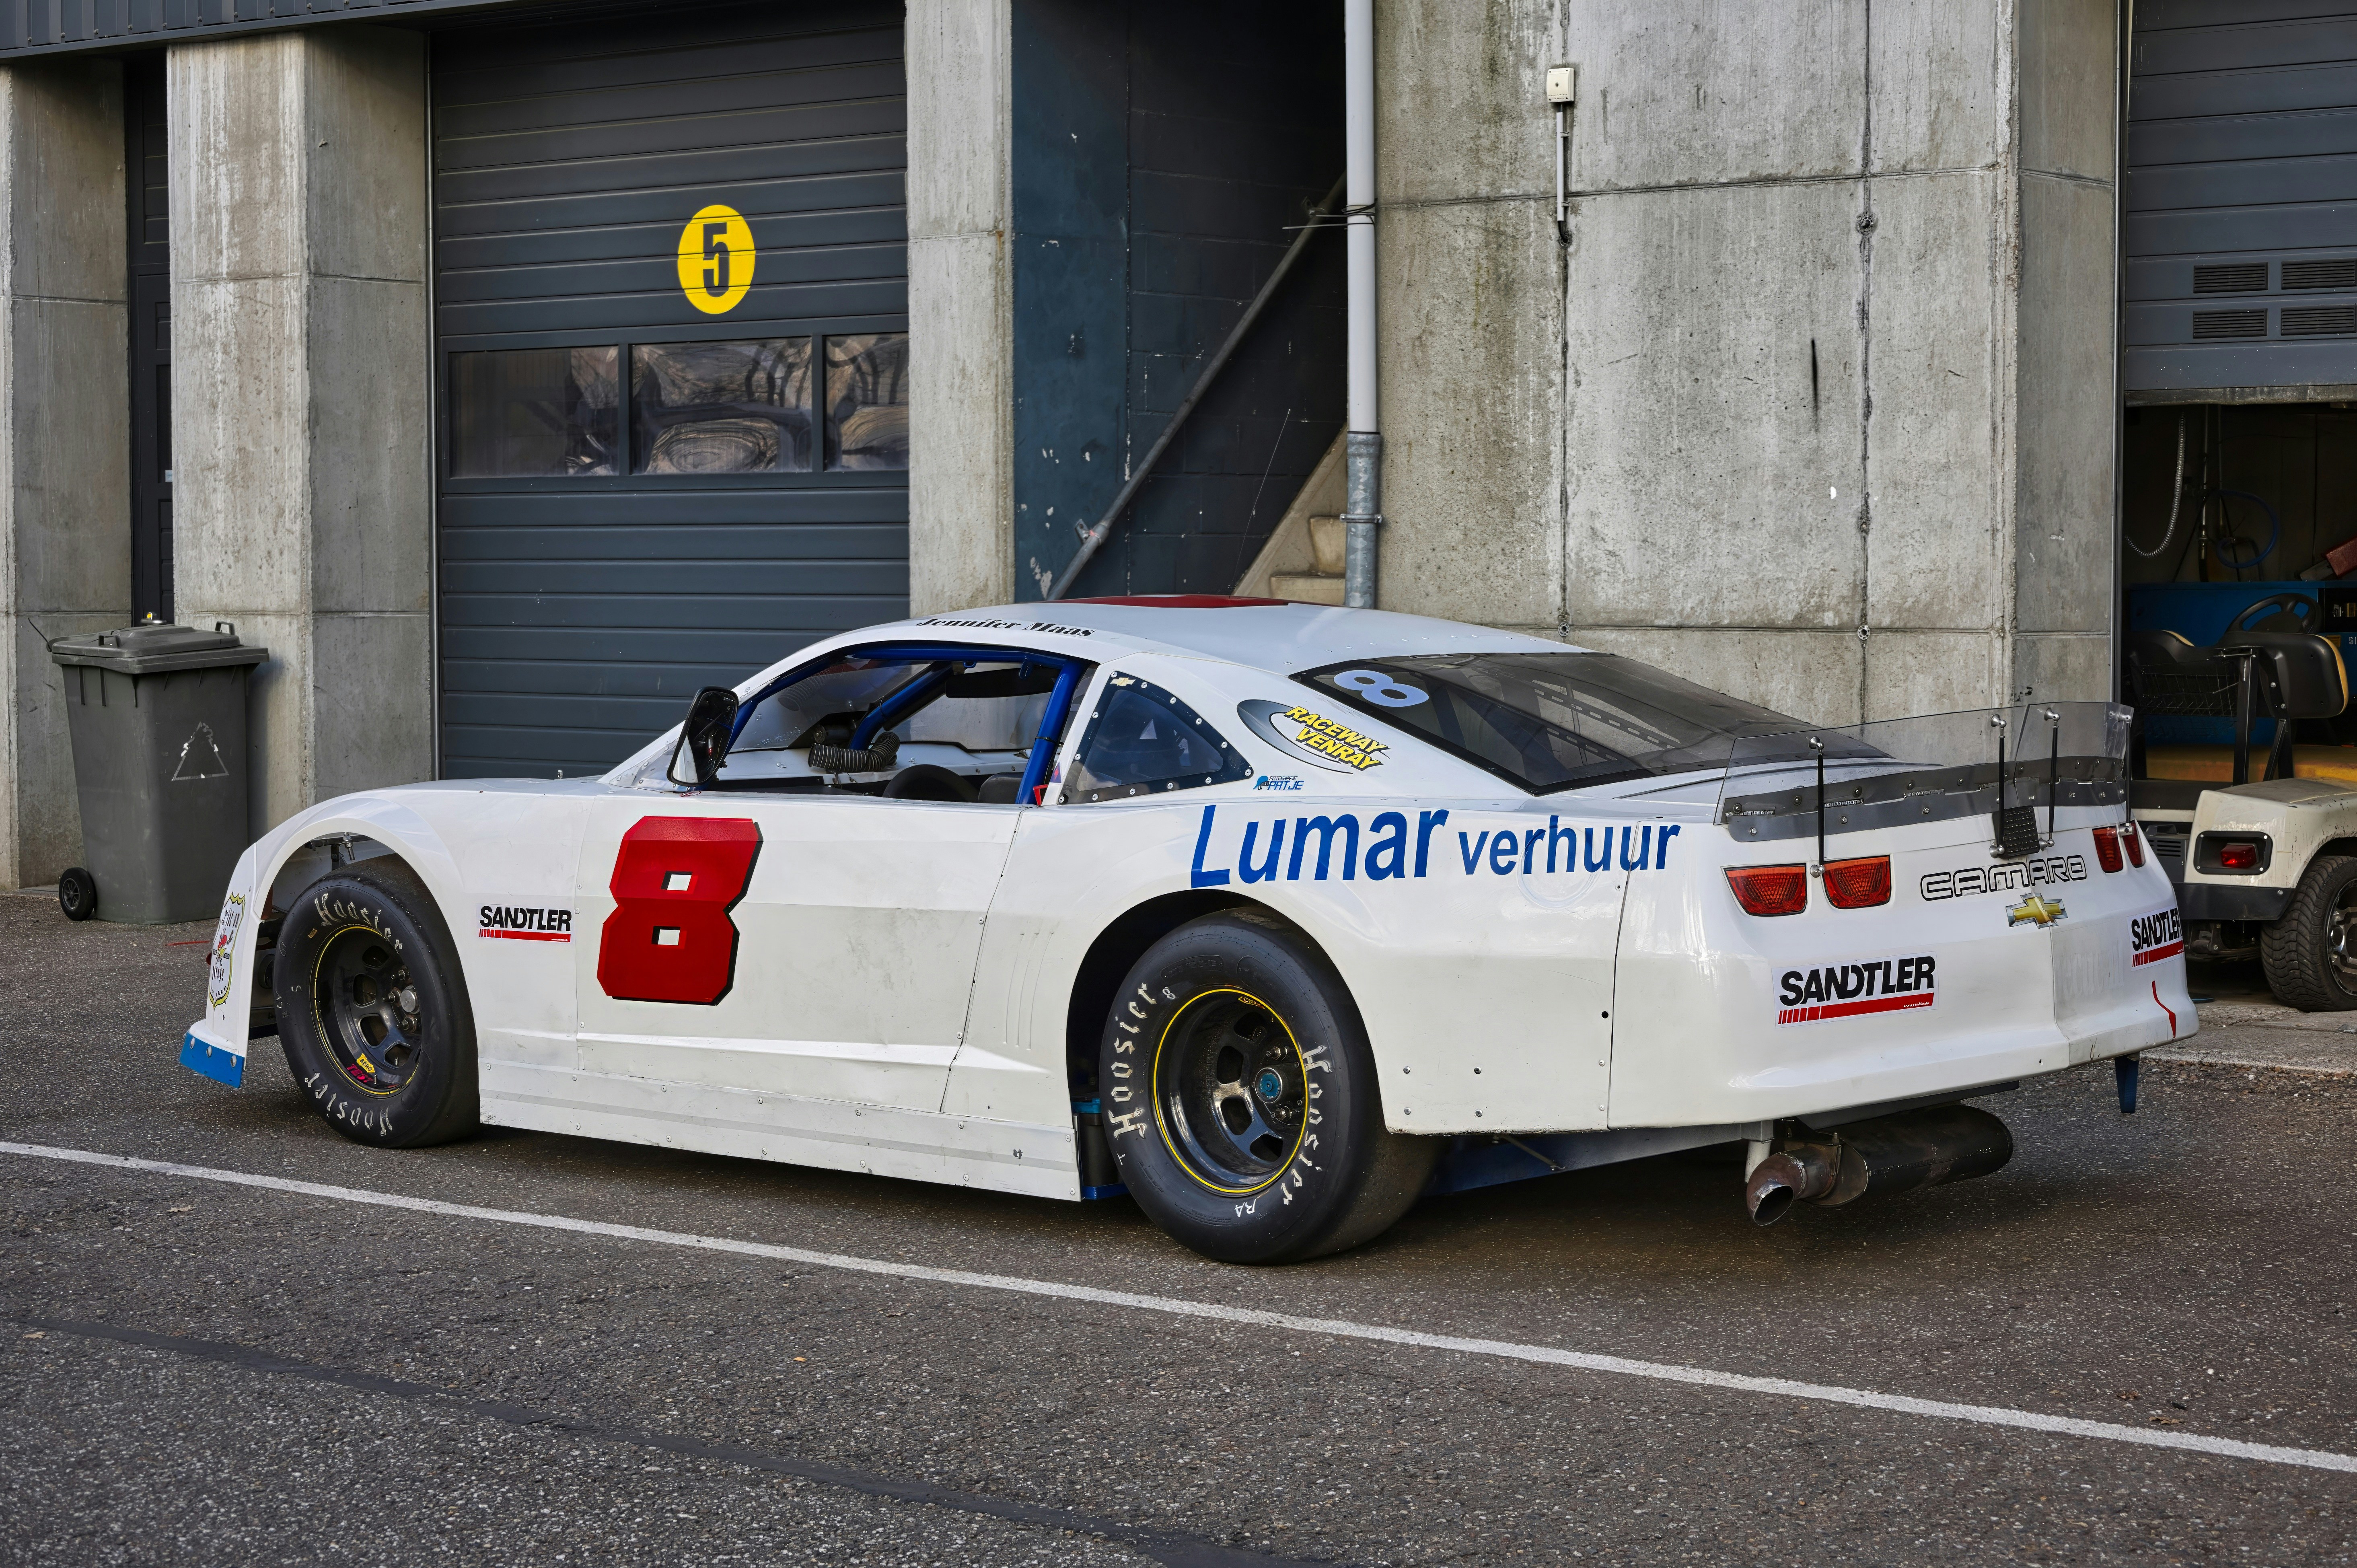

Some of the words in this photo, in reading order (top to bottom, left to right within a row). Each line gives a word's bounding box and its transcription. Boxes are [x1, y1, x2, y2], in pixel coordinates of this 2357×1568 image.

[703, 222, 730, 298] 5
[916, 618, 1022, 629] Jennifer
[1022, 622, 1096, 636] Maas
[1333, 670, 1429, 707] 8
[1283, 706, 1391, 755] RACEWAY
[1296, 727, 1384, 771] VENRAY
[1267, 781, 1304, 790] PATJE
[1191, 805, 1450, 889] Lumar
[1458, 815, 1681, 875] verhuur
[1920, 855, 2087, 901] CAMARO
[315, 893, 403, 955] Hoosier
[479, 905, 572, 932] SANDTLER
[596, 816, 764, 1006] 8
[2131, 907, 2182, 951] SANDTLER
[1779, 956, 1936, 1006] SANDTLER
[1107, 982, 1157, 1140] Hoosier
[304, 1072, 393, 1136] Hoosier
[1280, 1045, 1333, 1205] Hoosier
